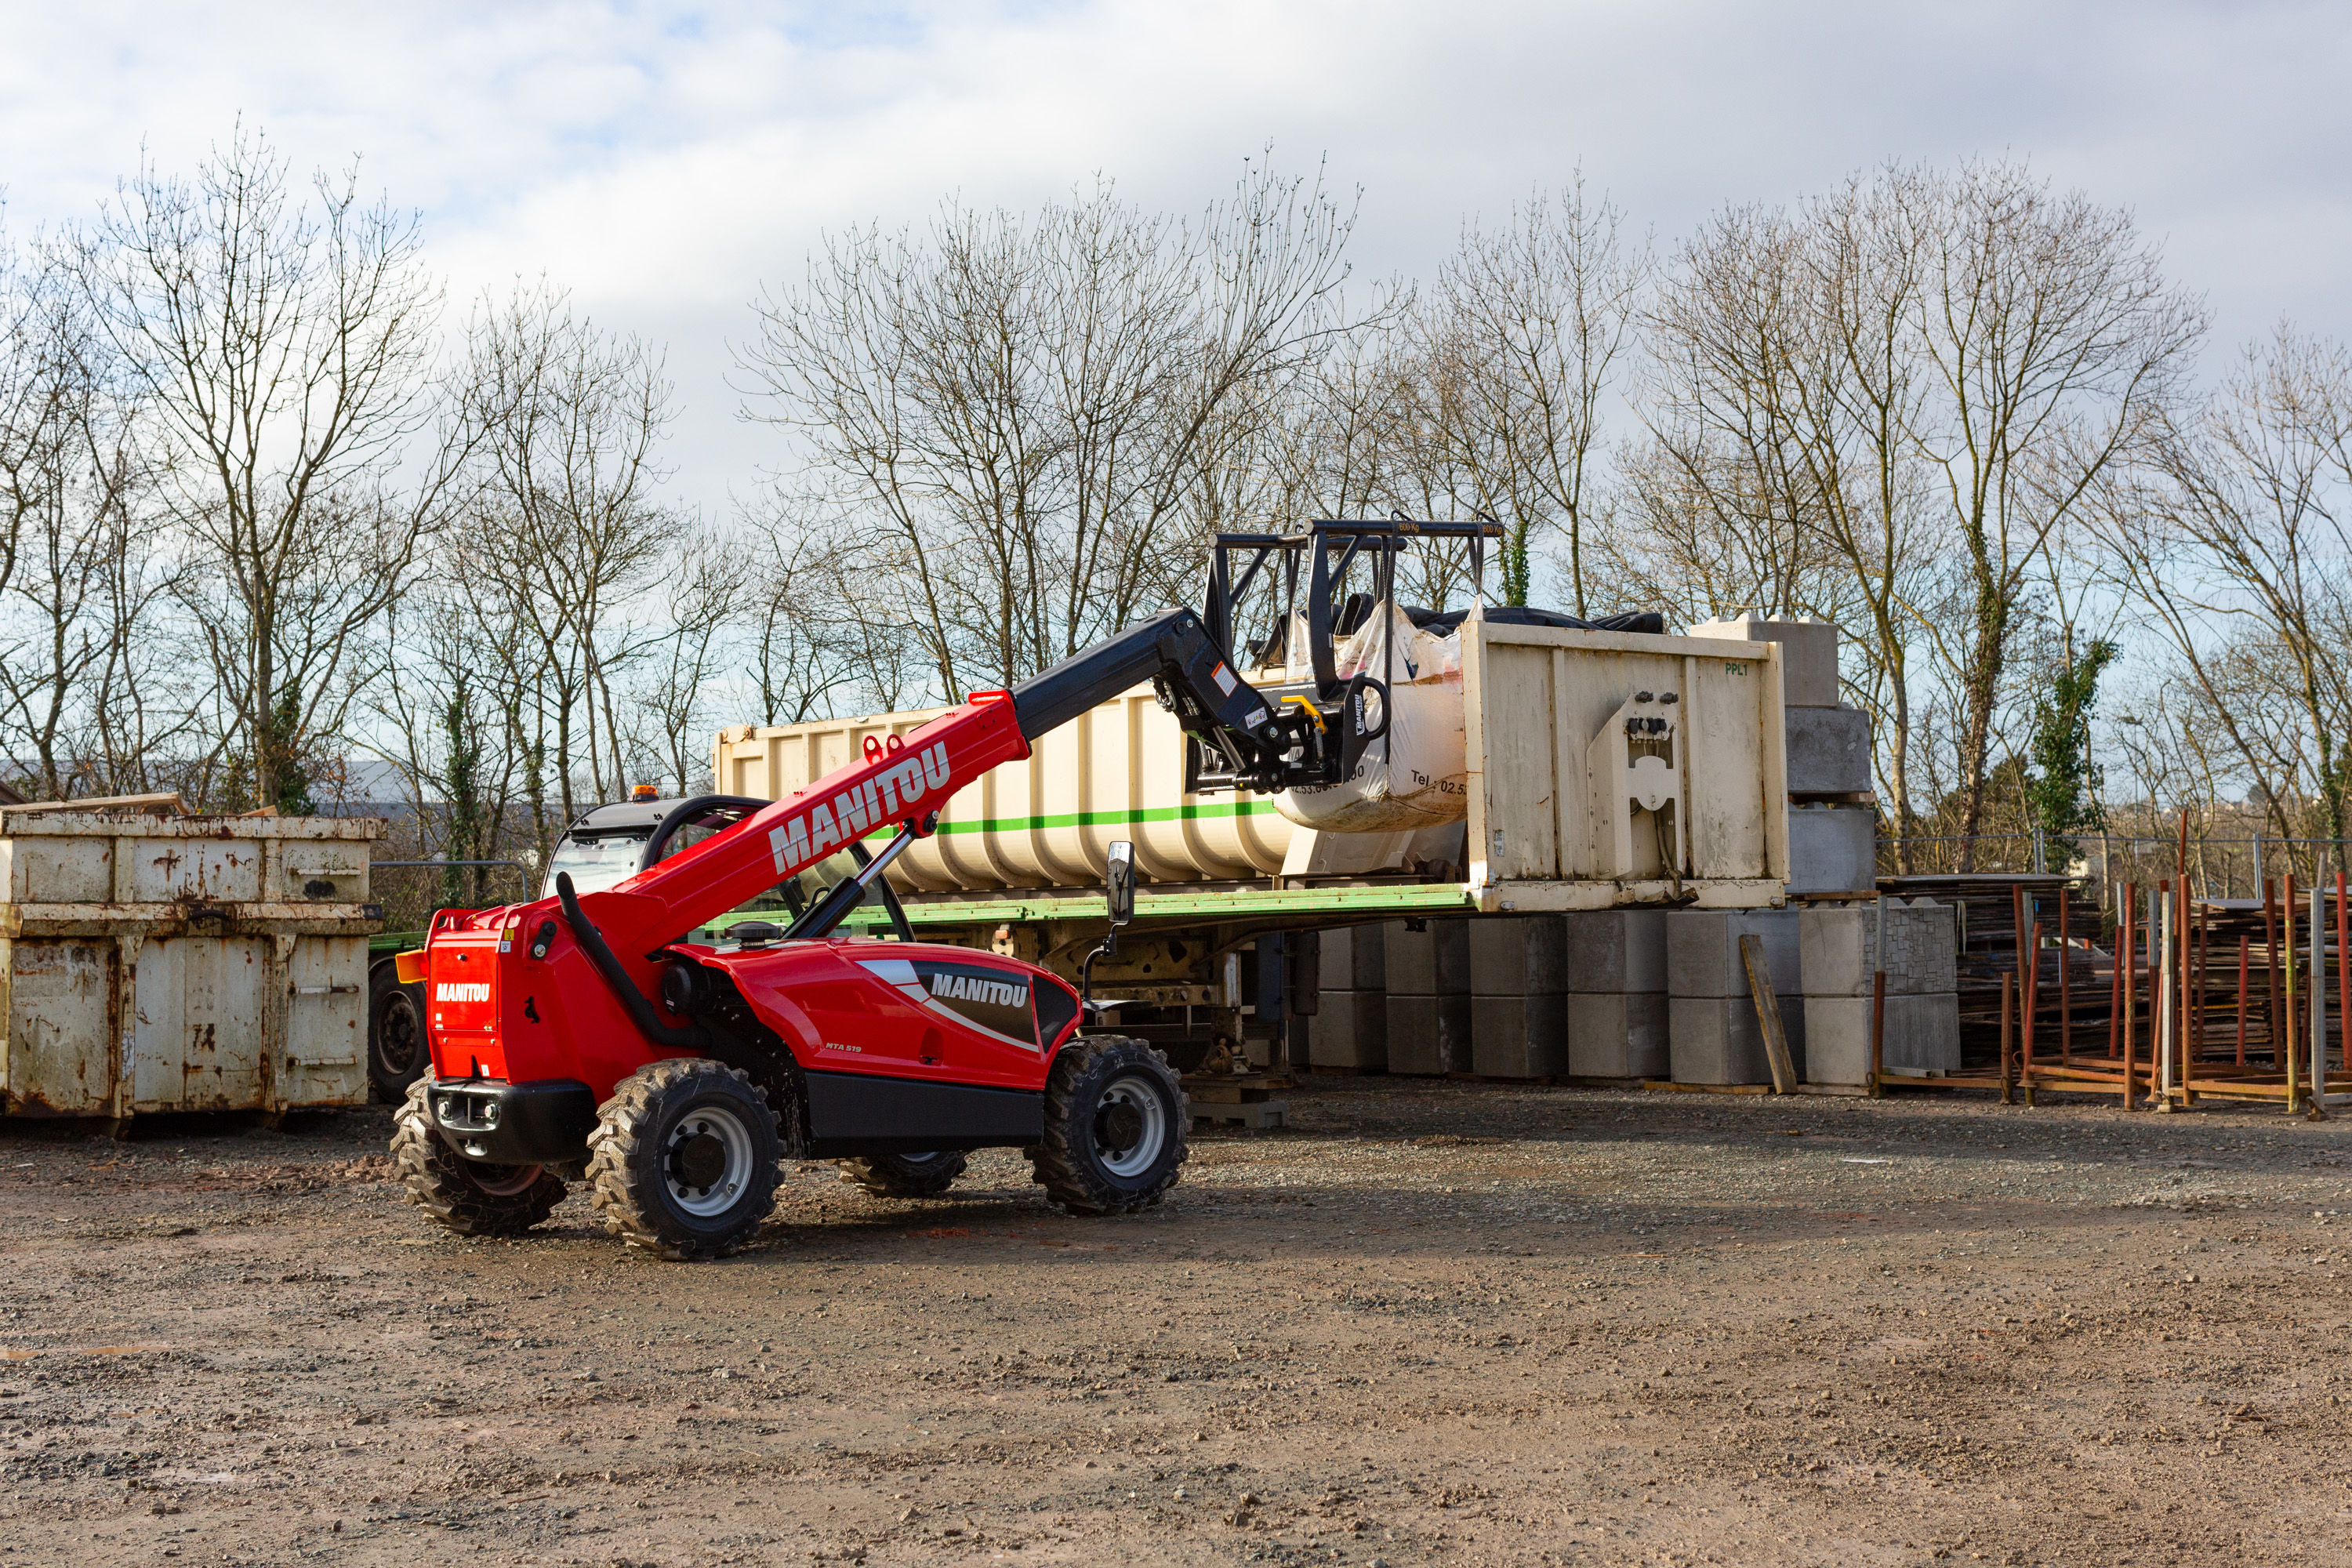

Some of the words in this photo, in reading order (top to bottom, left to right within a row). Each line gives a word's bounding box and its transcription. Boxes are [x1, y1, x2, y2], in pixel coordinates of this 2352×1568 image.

[1399, 522, 1410, 532] 600
[1411, 523, 1419, 533] Kg
[1483, 524, 1494, 533] 600
[1494, 524, 1502, 535] Kg
[1726, 662, 1748, 676] PPL1
[1411, 769, 1429, 786] Tel
[768, 741, 951, 876] MANITOU
[436, 983, 490, 1002] MANITOU
[931, 973, 1027, 1008] MANITOU
